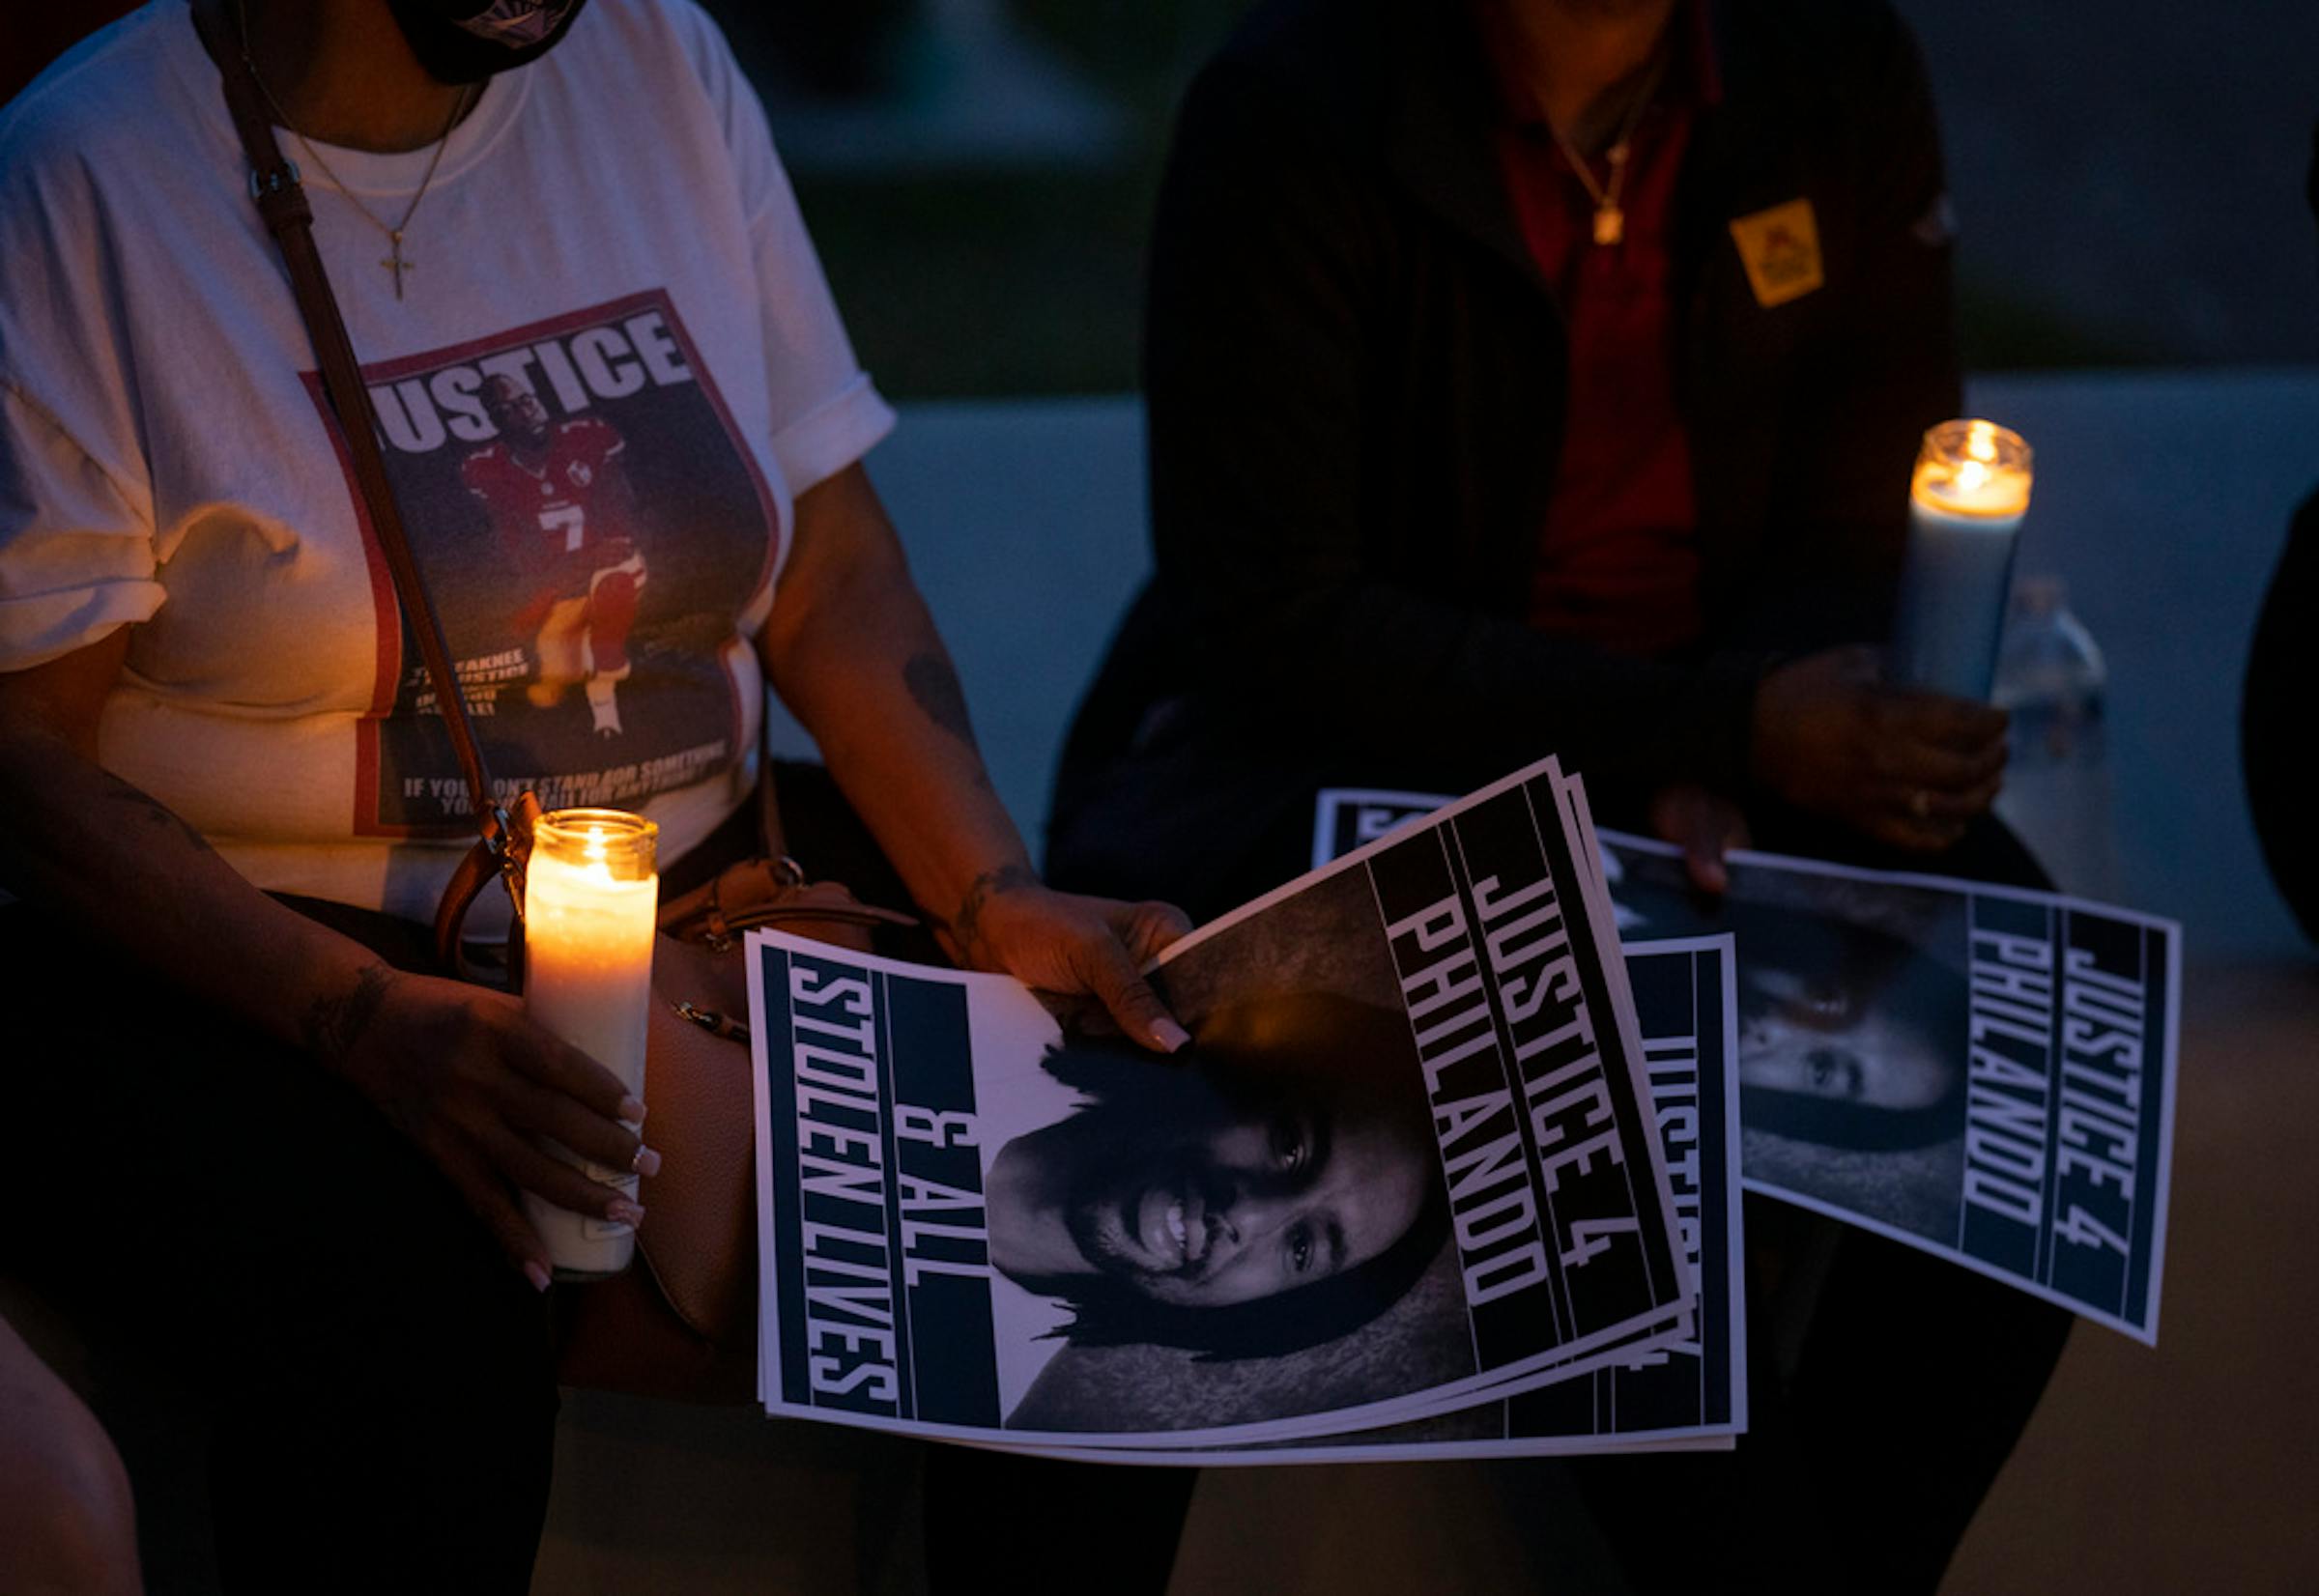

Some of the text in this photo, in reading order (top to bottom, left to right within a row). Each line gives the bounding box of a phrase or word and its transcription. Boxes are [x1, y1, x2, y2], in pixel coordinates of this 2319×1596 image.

[368, 312, 693, 454] USTICE
[538, 504, 585, 553] 7
[403, 777, 425, 799] IF
[788, 965, 900, 1403] STOLEN LIVES
[893, 1102, 990, 1289] & ALL
[1386, 894, 1548, 1308] PHILANDO
[1470, 873, 1640, 1268] JUSTICE 4
[1963, 926, 2054, 1227] PHILANDO
[2051, 946, 2145, 1257] JUSTICE 4
